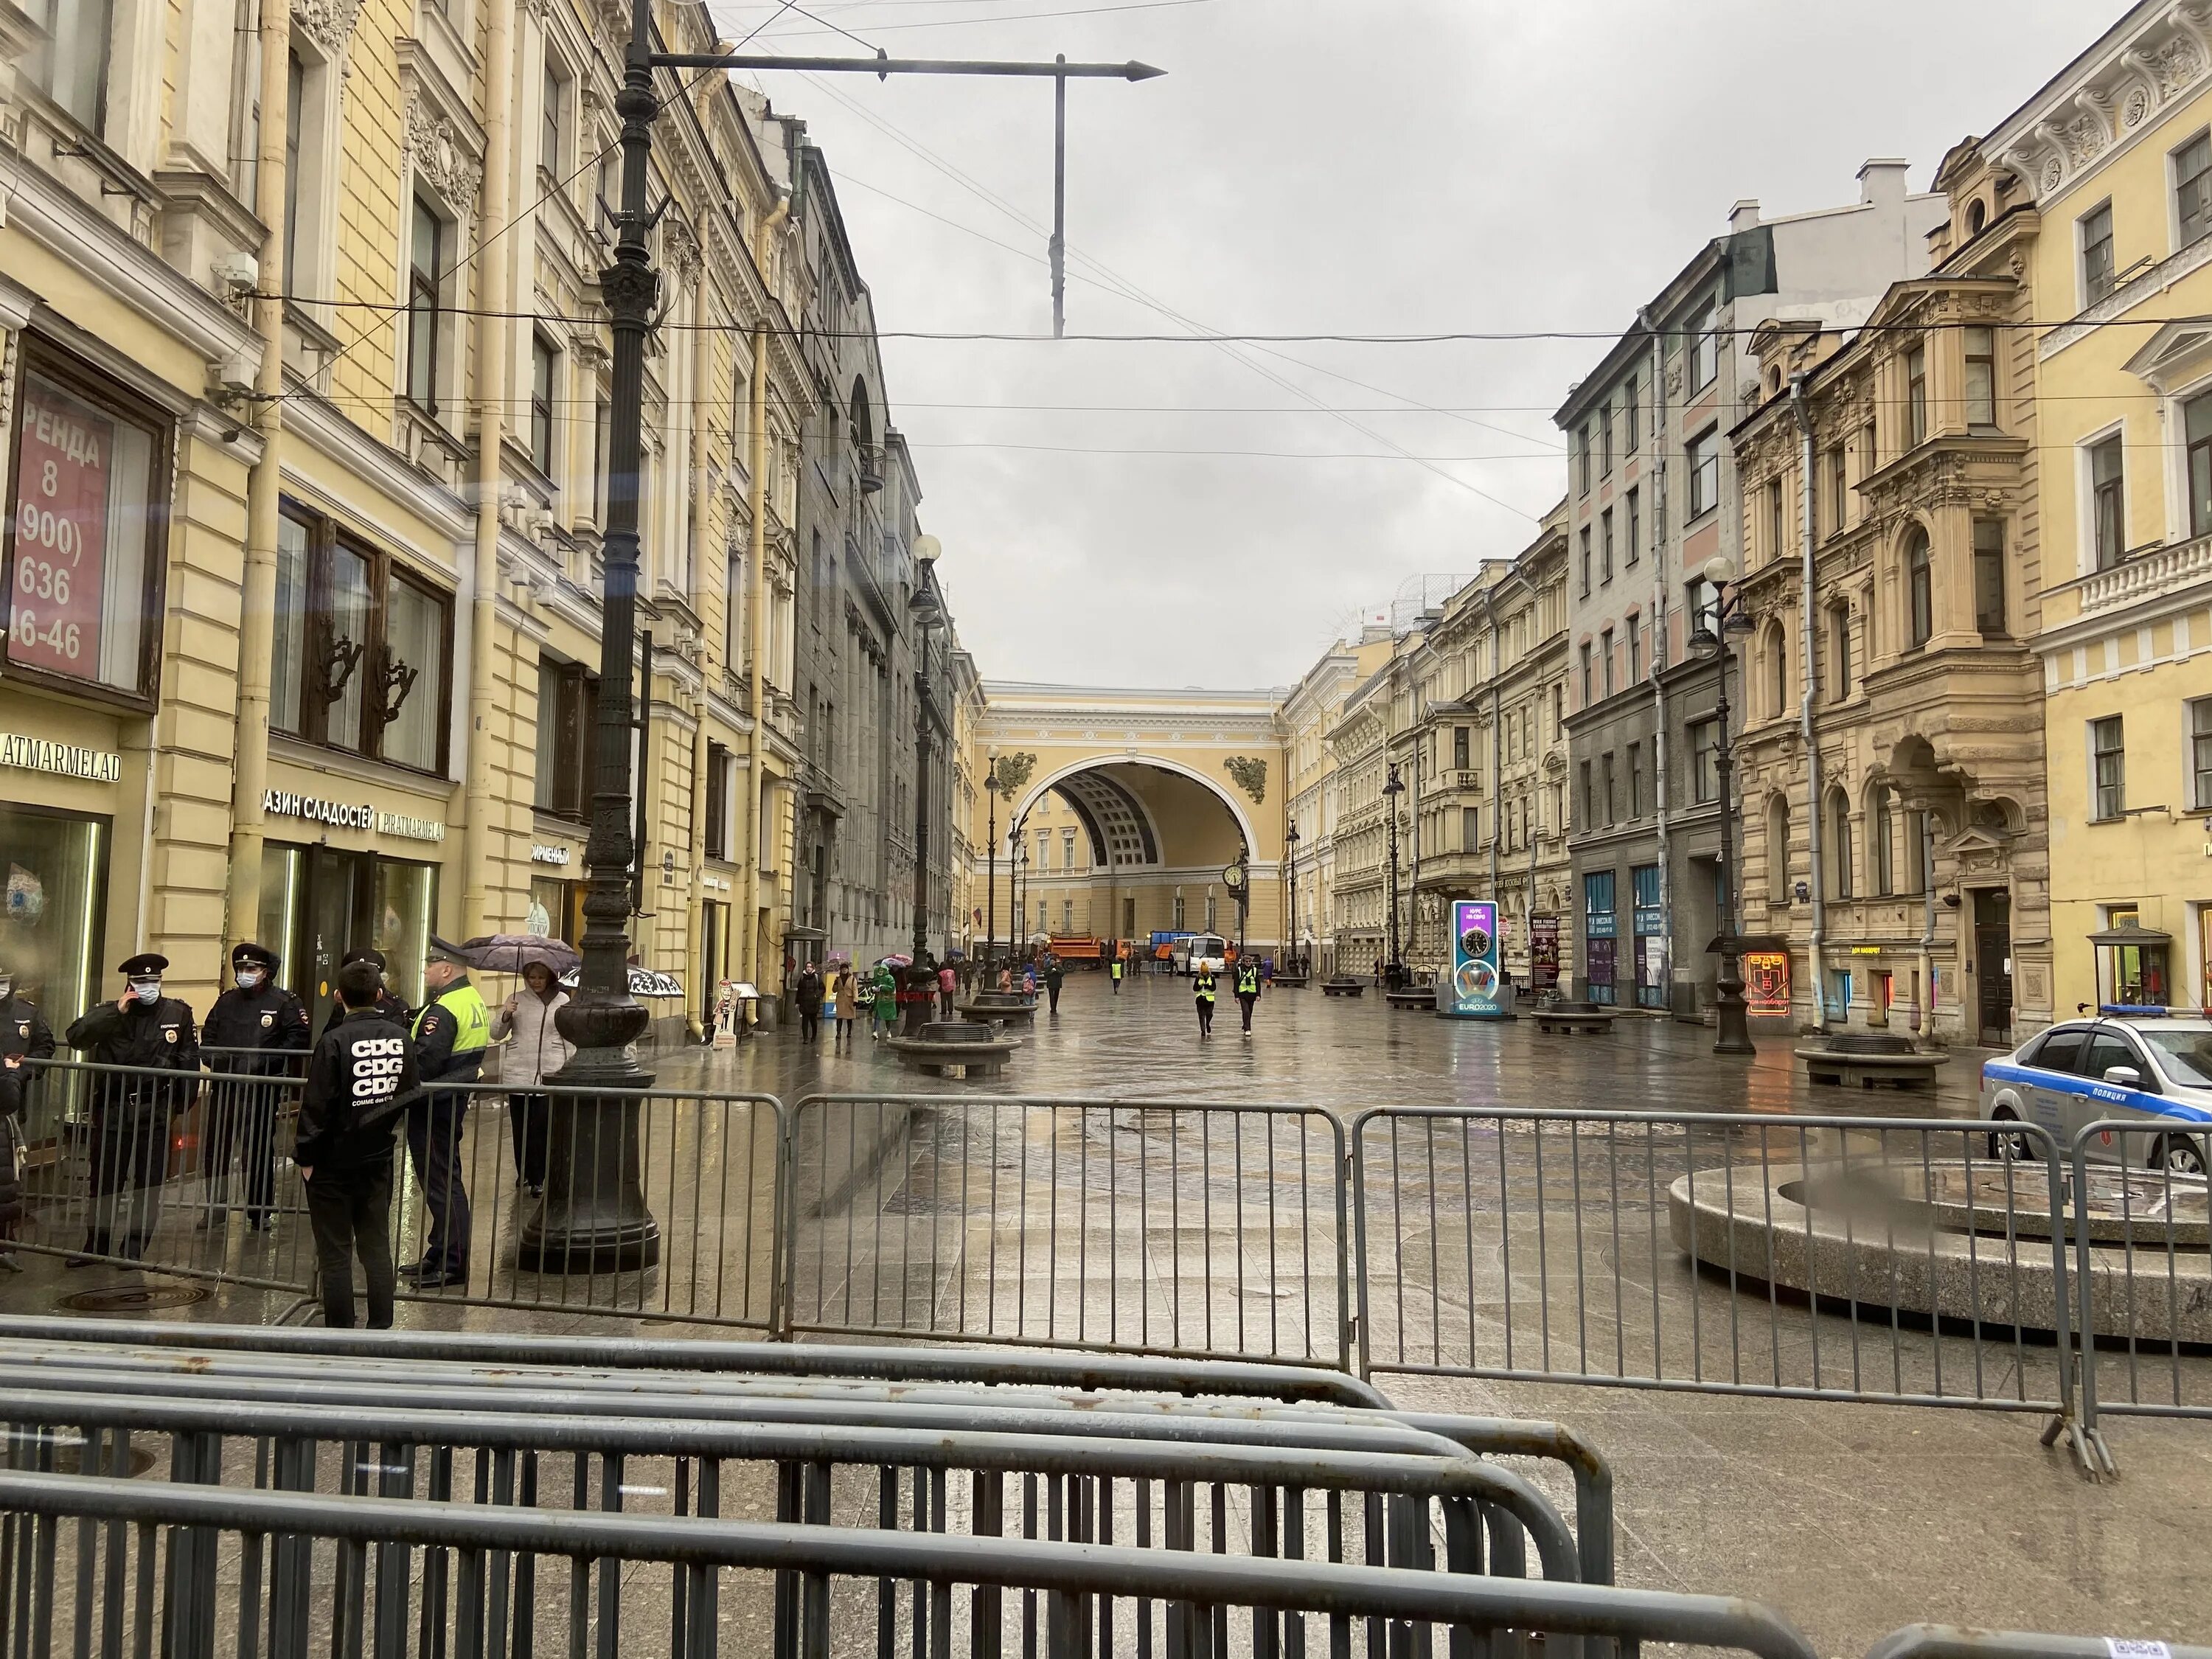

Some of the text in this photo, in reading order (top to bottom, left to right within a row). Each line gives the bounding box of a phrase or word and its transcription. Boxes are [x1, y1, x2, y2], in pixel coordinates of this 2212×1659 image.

[42, 459, 58, 497] 8
[15, 499, 82, 568] (900)
[20, 556, 70, 605] 636
[2, 734, 122, 782] ATMARMELAD
[261, 789, 445, 841] АЗИН СЛАДОСТЕЙ PIRATMARMELAD
[2203, 842, 2212, 855] П
[351, 1038, 403, 1057] CDG
[352, 1057, 403, 1077] CDG
[352, 1076, 399, 1096] CDG
[2093, 1087, 2126, 1102] ПОЛИЦИЯ
[352, 1098, 375, 1106] COMME
